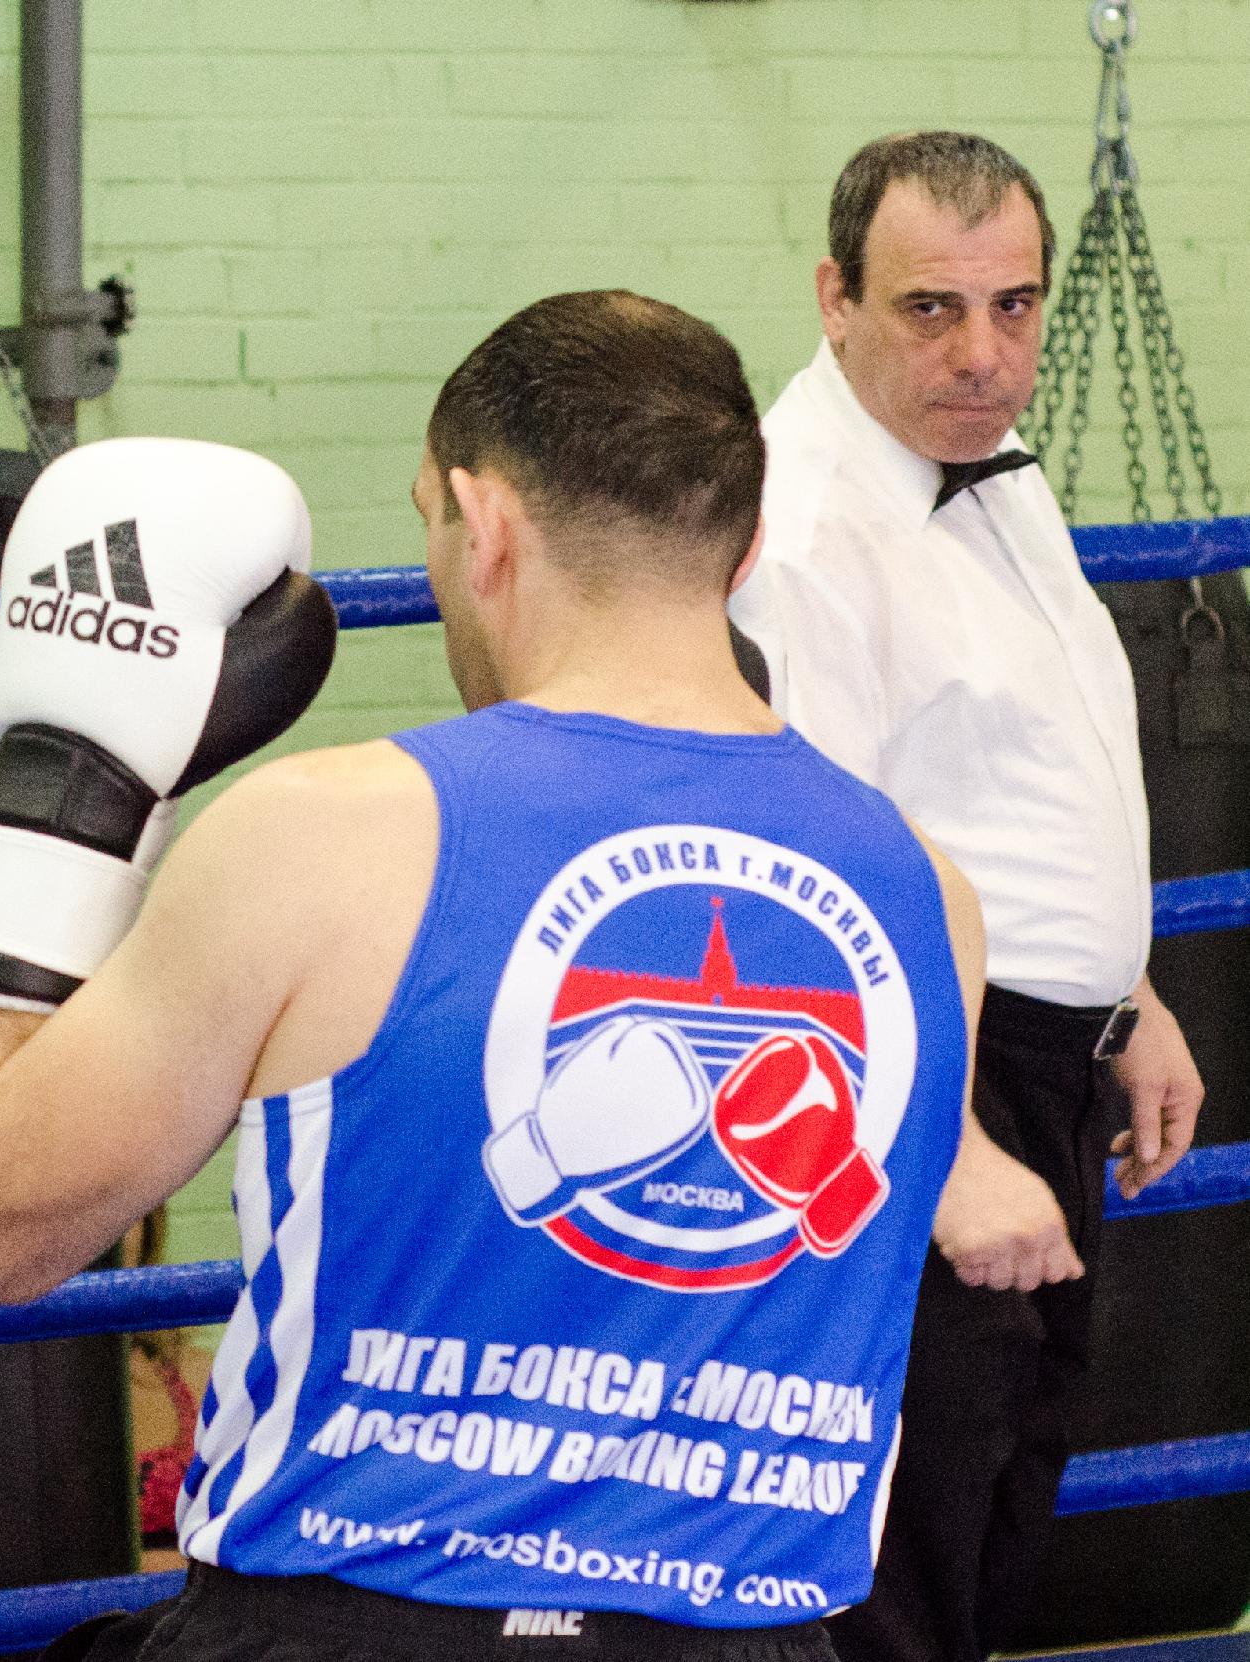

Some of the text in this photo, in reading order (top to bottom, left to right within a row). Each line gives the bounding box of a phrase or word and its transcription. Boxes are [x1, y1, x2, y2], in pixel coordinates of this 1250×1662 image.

[7, 591, 181, 660] adidas
[537, 874, 605, 956] ЛИГА
[608, 841, 721, 885] БОКСА
[642, 1183, 744, 1213] МОСКВА
[341, 1328, 467, 1397] ЛИГА
[472, 1342, 666, 1421] БОКСА
[307, 1402, 554, 1477] MOSCOW
[502, 1608, 585, 1637] NIKE
